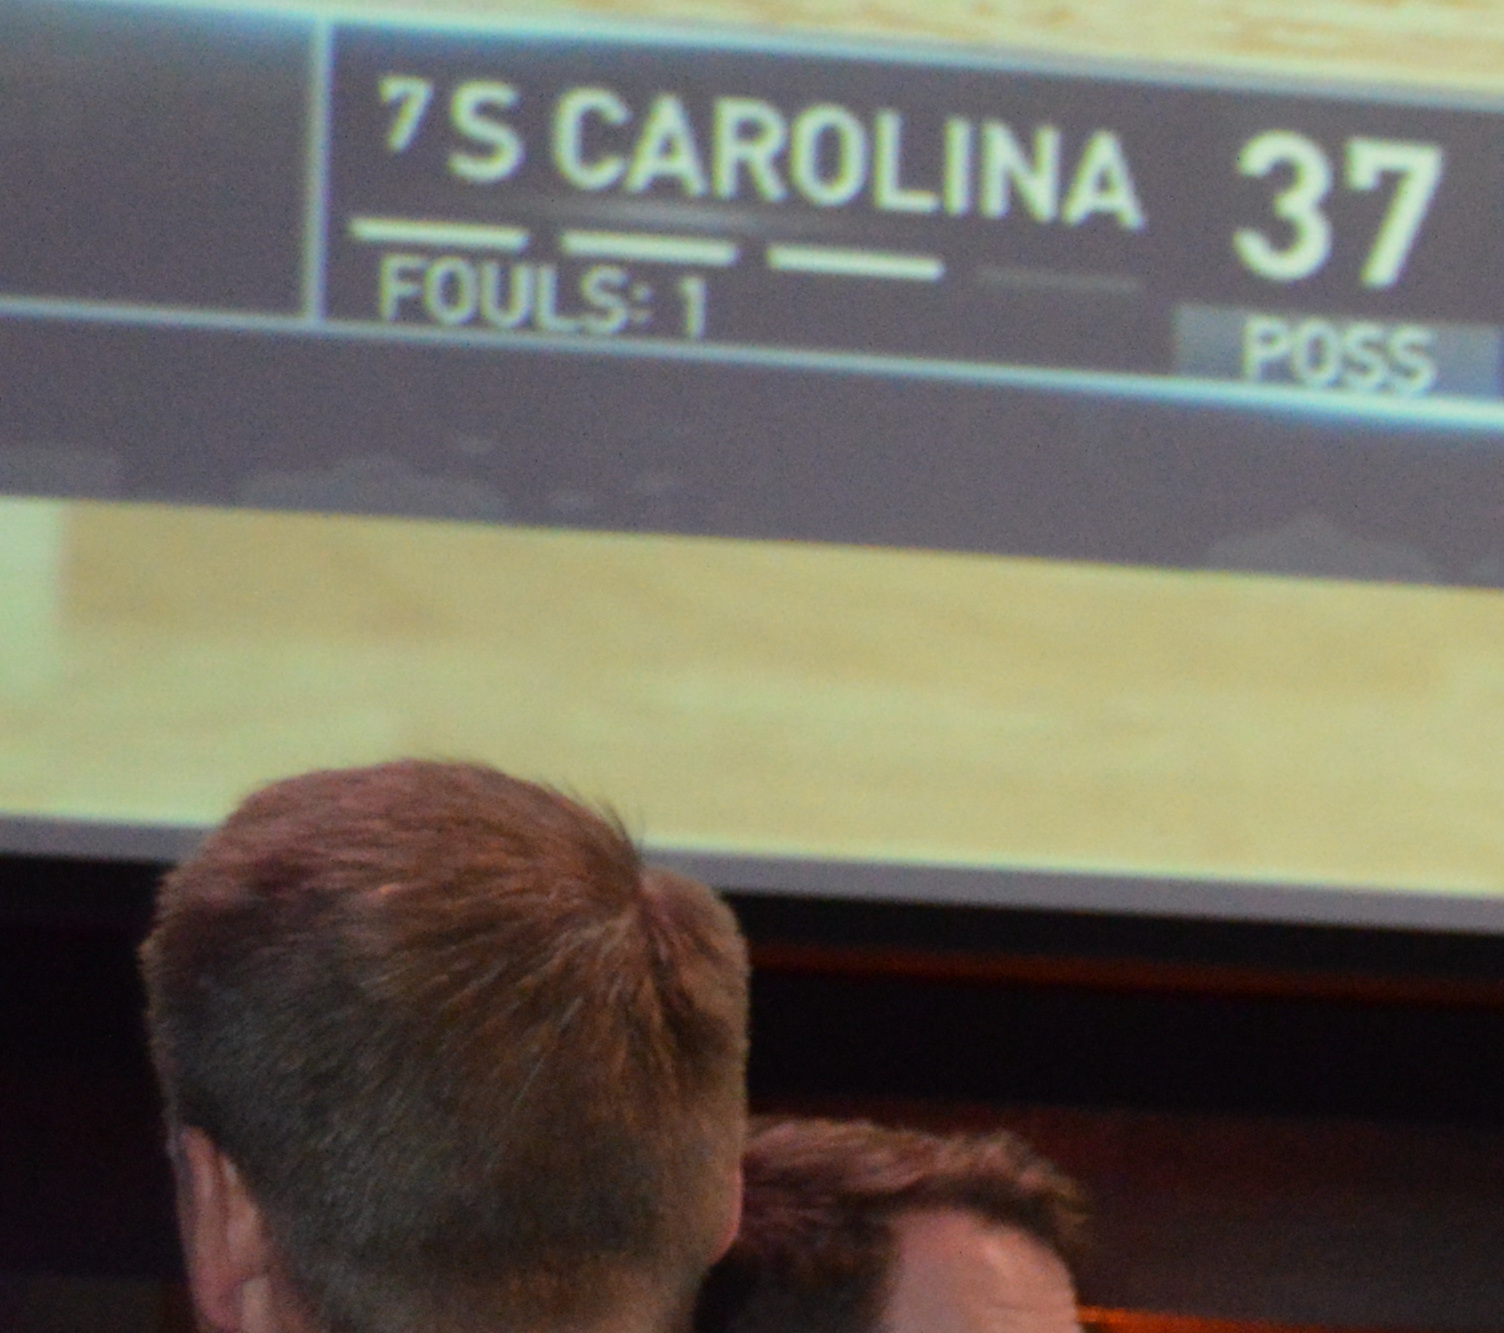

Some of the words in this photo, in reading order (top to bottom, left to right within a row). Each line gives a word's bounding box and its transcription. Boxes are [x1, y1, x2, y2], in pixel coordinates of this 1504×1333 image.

[379, 74, 431, 153] 7
[447, 80, 524, 184] S
[550, 86, 1148, 233] CAROLINA
[1233, 130, 1444, 290] 37
[378, 253, 655, 337] FOULS:
[677, 275, 709, 341] 1
[1240, 315, 1440, 399] POSS
